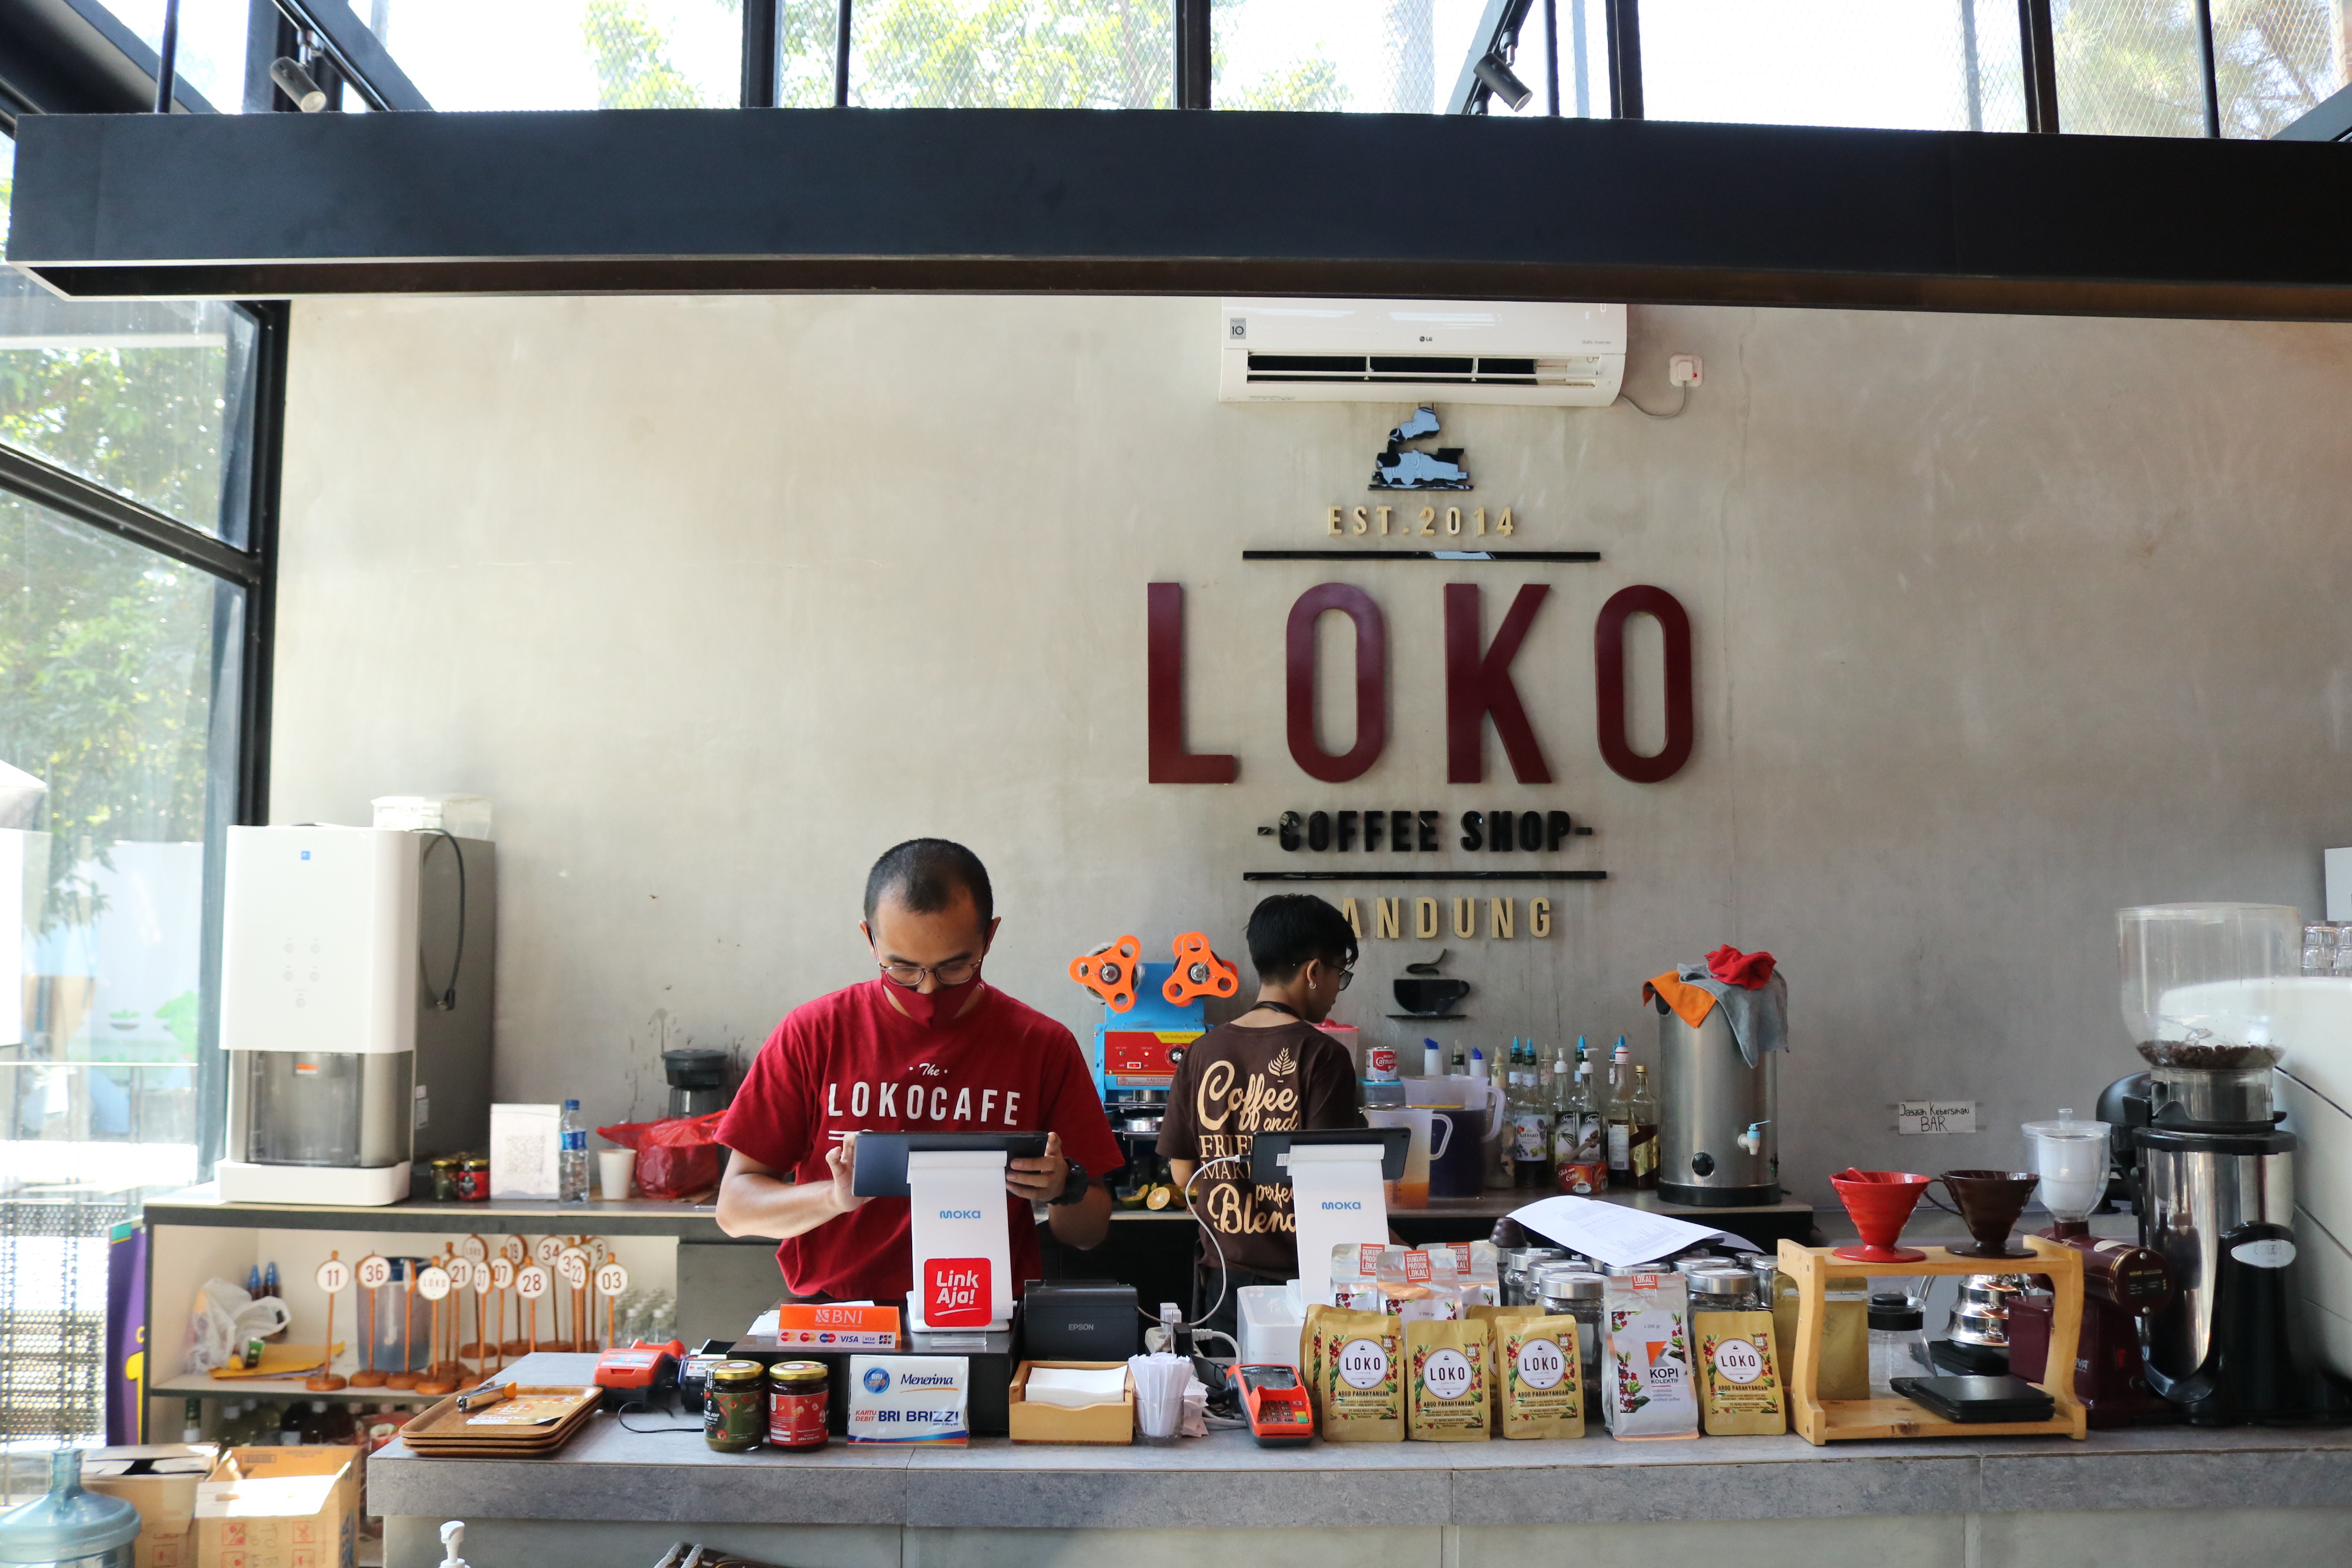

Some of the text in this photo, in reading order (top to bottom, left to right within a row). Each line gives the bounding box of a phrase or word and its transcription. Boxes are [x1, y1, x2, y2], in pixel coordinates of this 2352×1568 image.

[1147, 582, 1694, 784] LOKO
[1279, 811, 1570, 851] COFFEE SHOP
[1341, 897, 1551, 939] ANDUNG
[919, 1063, 940, 1077] The
[828, 1081, 1021, 1126] LOKOCAFE
[1197, 1060, 1298, 1132] Coffee
[1263, 1110, 1298, 1132] and
[1920, 1116, 1948, 1132] BAR
[1199, 1135, 1253, 1158] FRIE
[1256, 1182, 1293, 1208] perfe
[543, 1244, 560, 1260] 34
[326, 1269, 339, 1286] 11
[367, 1264, 383, 1282] 36
[452, 1265, 466, 1282] 21
[603, 1272, 621, 1289] 03
[936, 1270, 979, 1288] Link
[1407, 1269, 1429, 1277] LOKAL!
[1634, 1275, 1655, 1283] LOKAL!
[523, 1273, 541, 1292] 28
[936, 1286, 975, 1308] Aja!
[832, 1309, 863, 1324] BNI
[1346, 1357, 1380, 1370] LOKO
[1524, 1357, 1558, 1371] LOKO
[1720, 1355, 1756, 1367] LOKO
[2075, 1358, 2089, 1370] VA
[901, 1374, 953, 1385] Menerima
[1430, 1367, 1465, 1381] LOKO
[1649, 1368, 1679, 1379] KOPI
[878, 1410, 959, 1422] BRI BRIZZI
